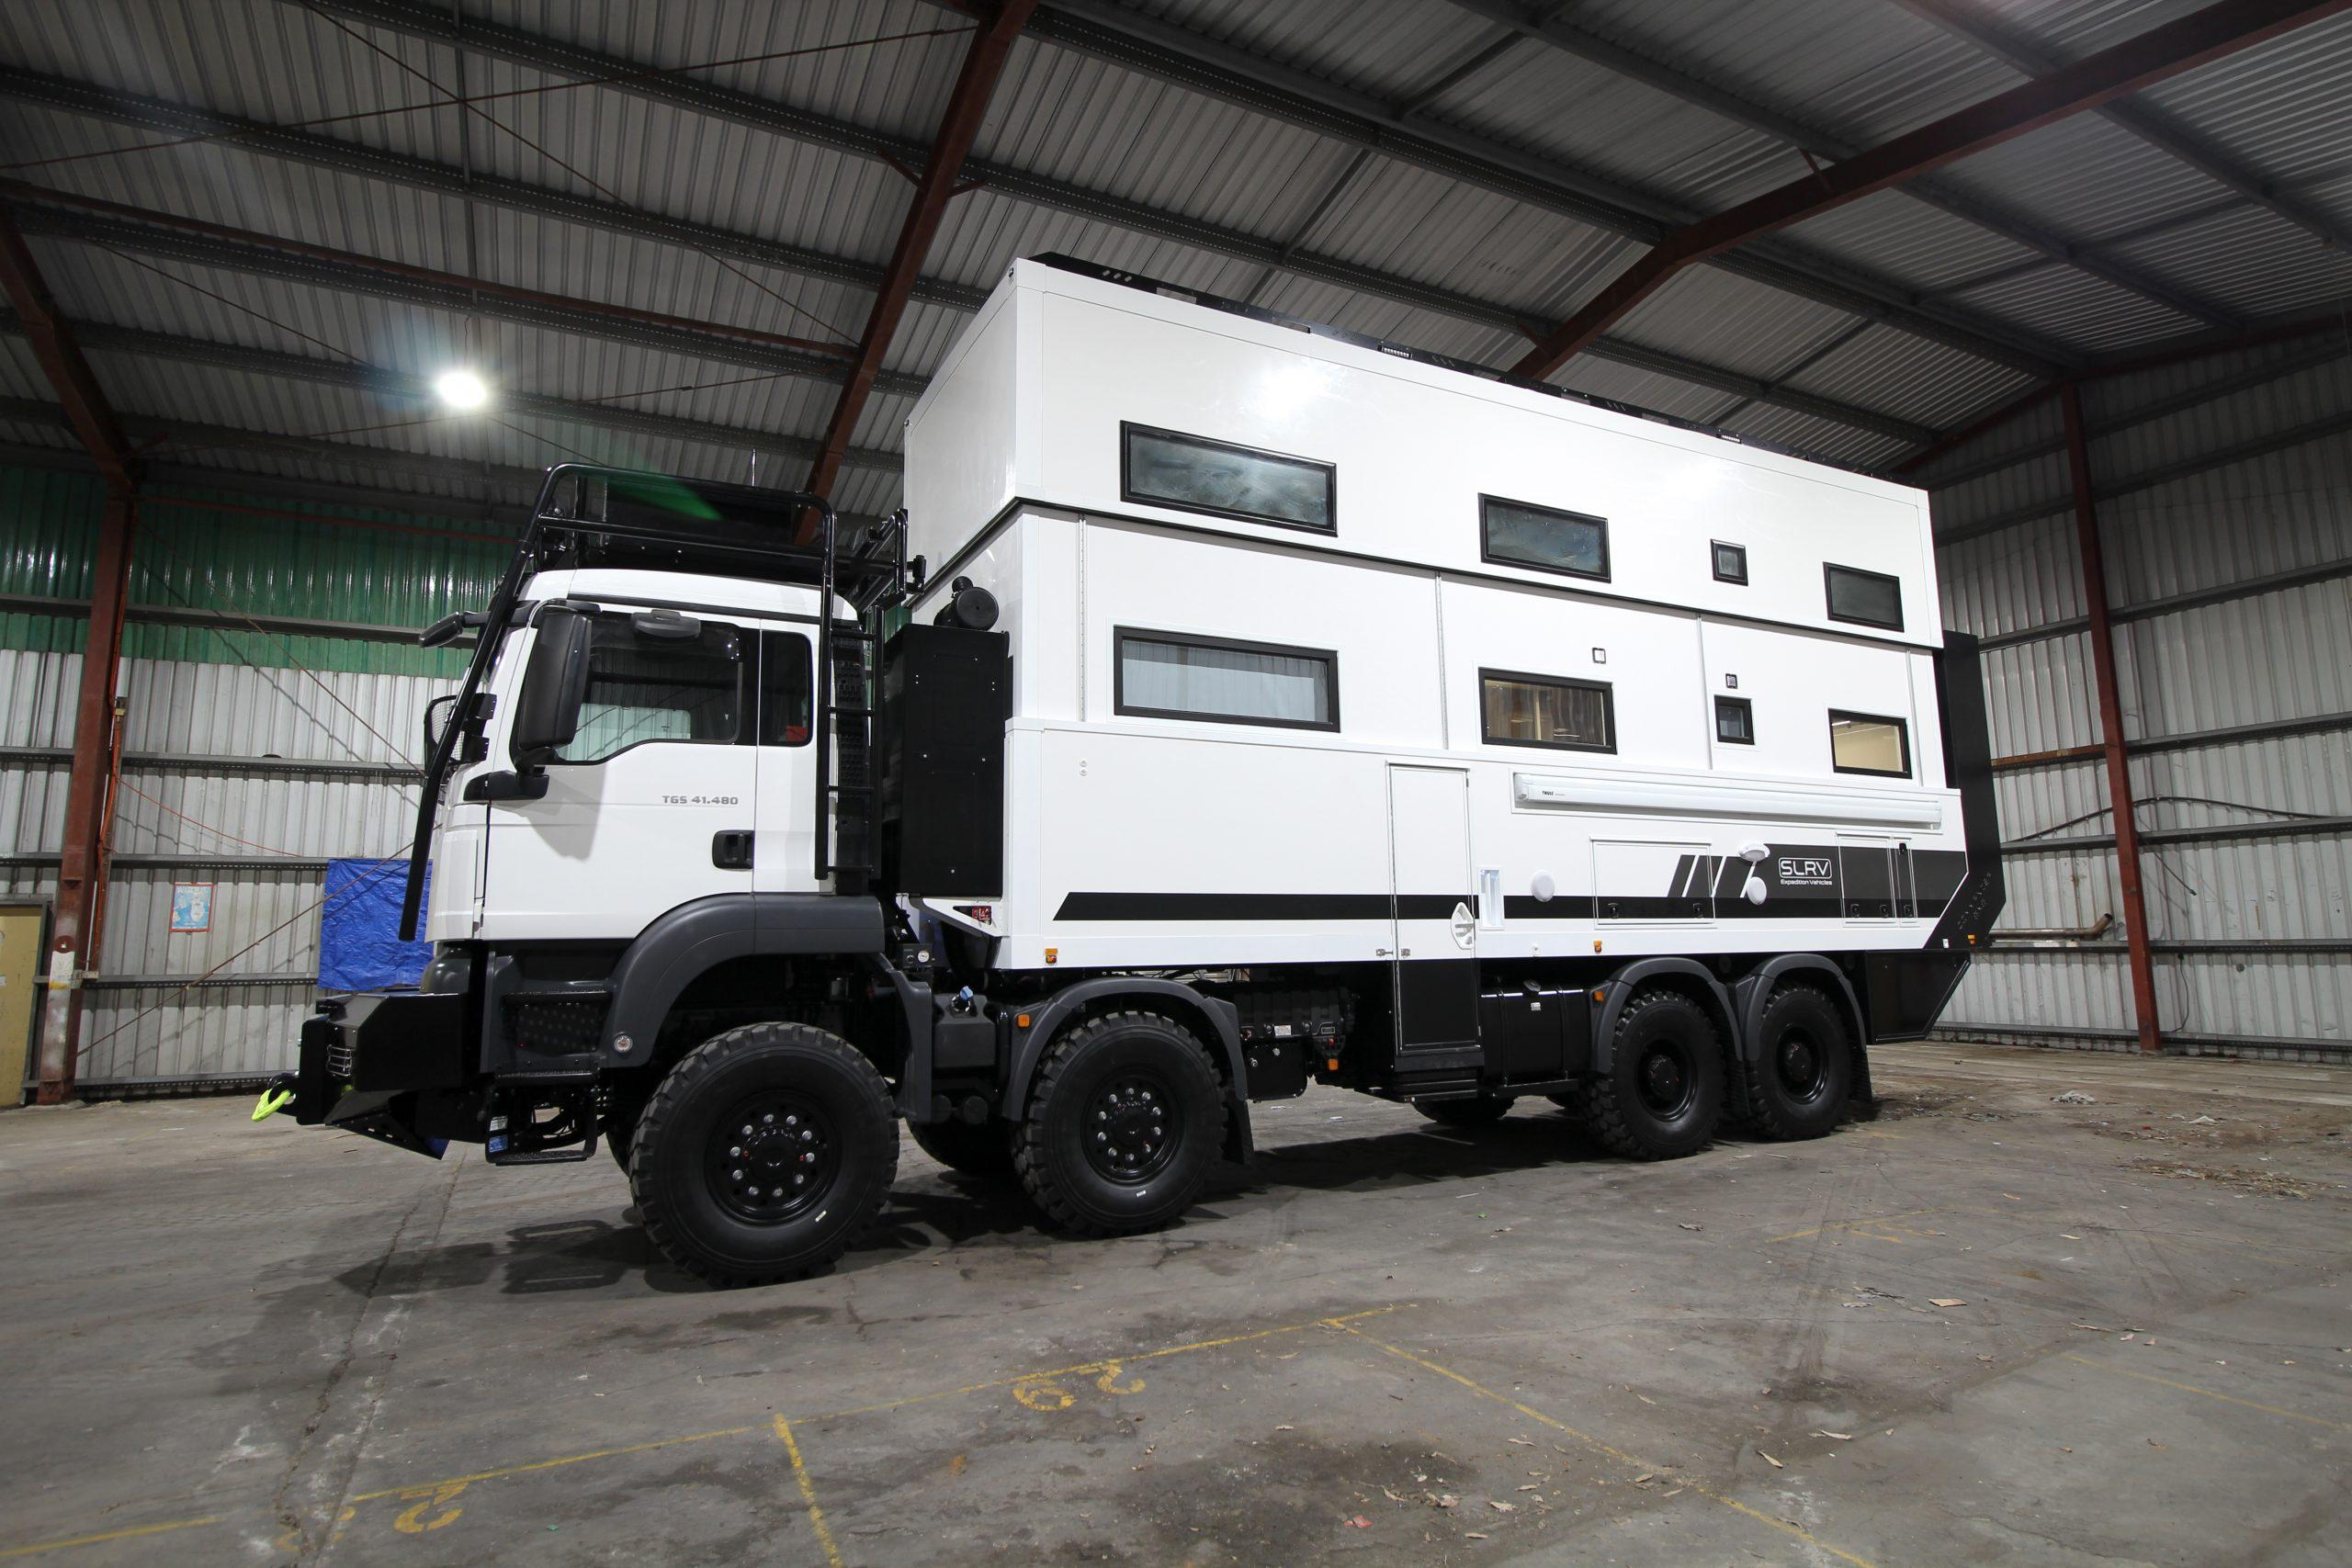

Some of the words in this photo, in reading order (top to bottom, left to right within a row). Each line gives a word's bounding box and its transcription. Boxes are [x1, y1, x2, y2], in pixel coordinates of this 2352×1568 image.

[662, 795, 687, 804] TGS
[691, 795, 739, 805] 41.480
[1781, 860, 1828, 876] SLRV
